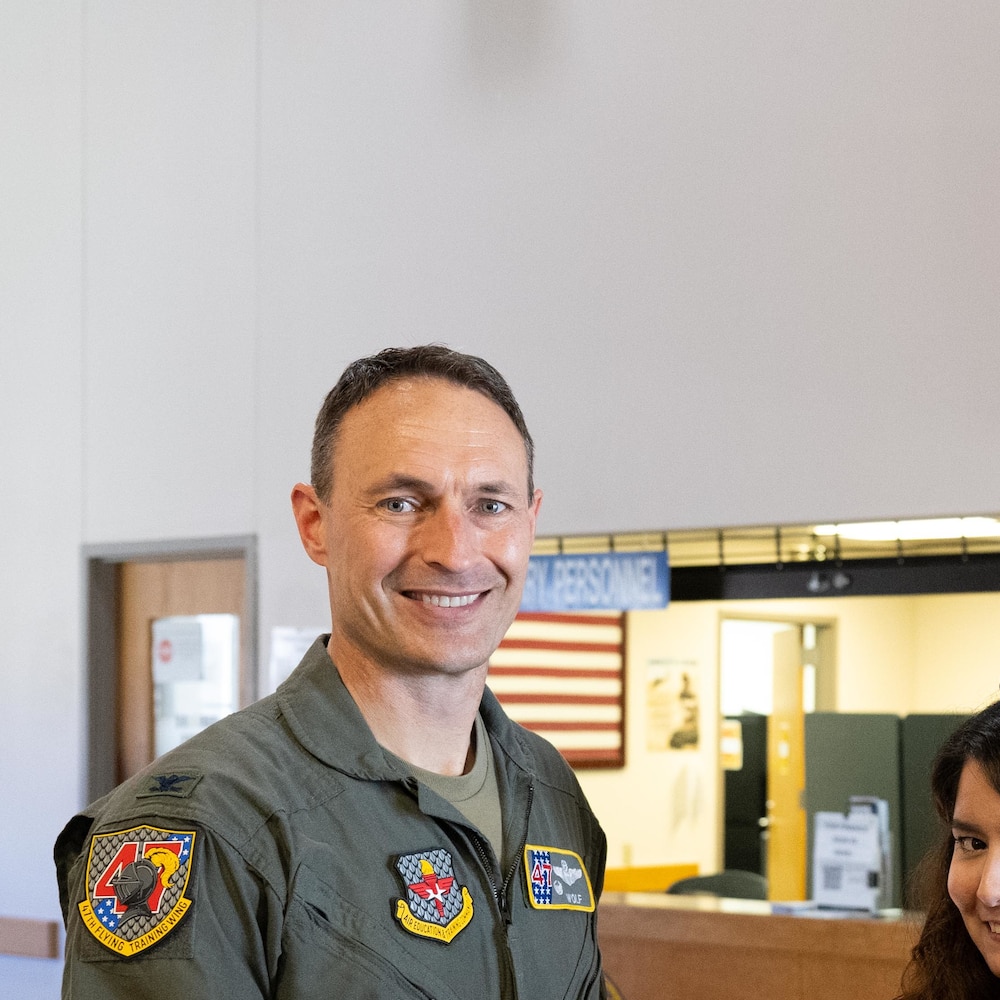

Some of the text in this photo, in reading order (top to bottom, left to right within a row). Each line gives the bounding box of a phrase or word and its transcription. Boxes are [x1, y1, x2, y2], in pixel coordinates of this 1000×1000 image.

[553, 557, 662, 605] PERSONNEL
[93, 840, 184, 915] 47
[531, 863, 553, 887] 47
[81, 900, 188, 952] 47TH FLYING TRAINING WING
